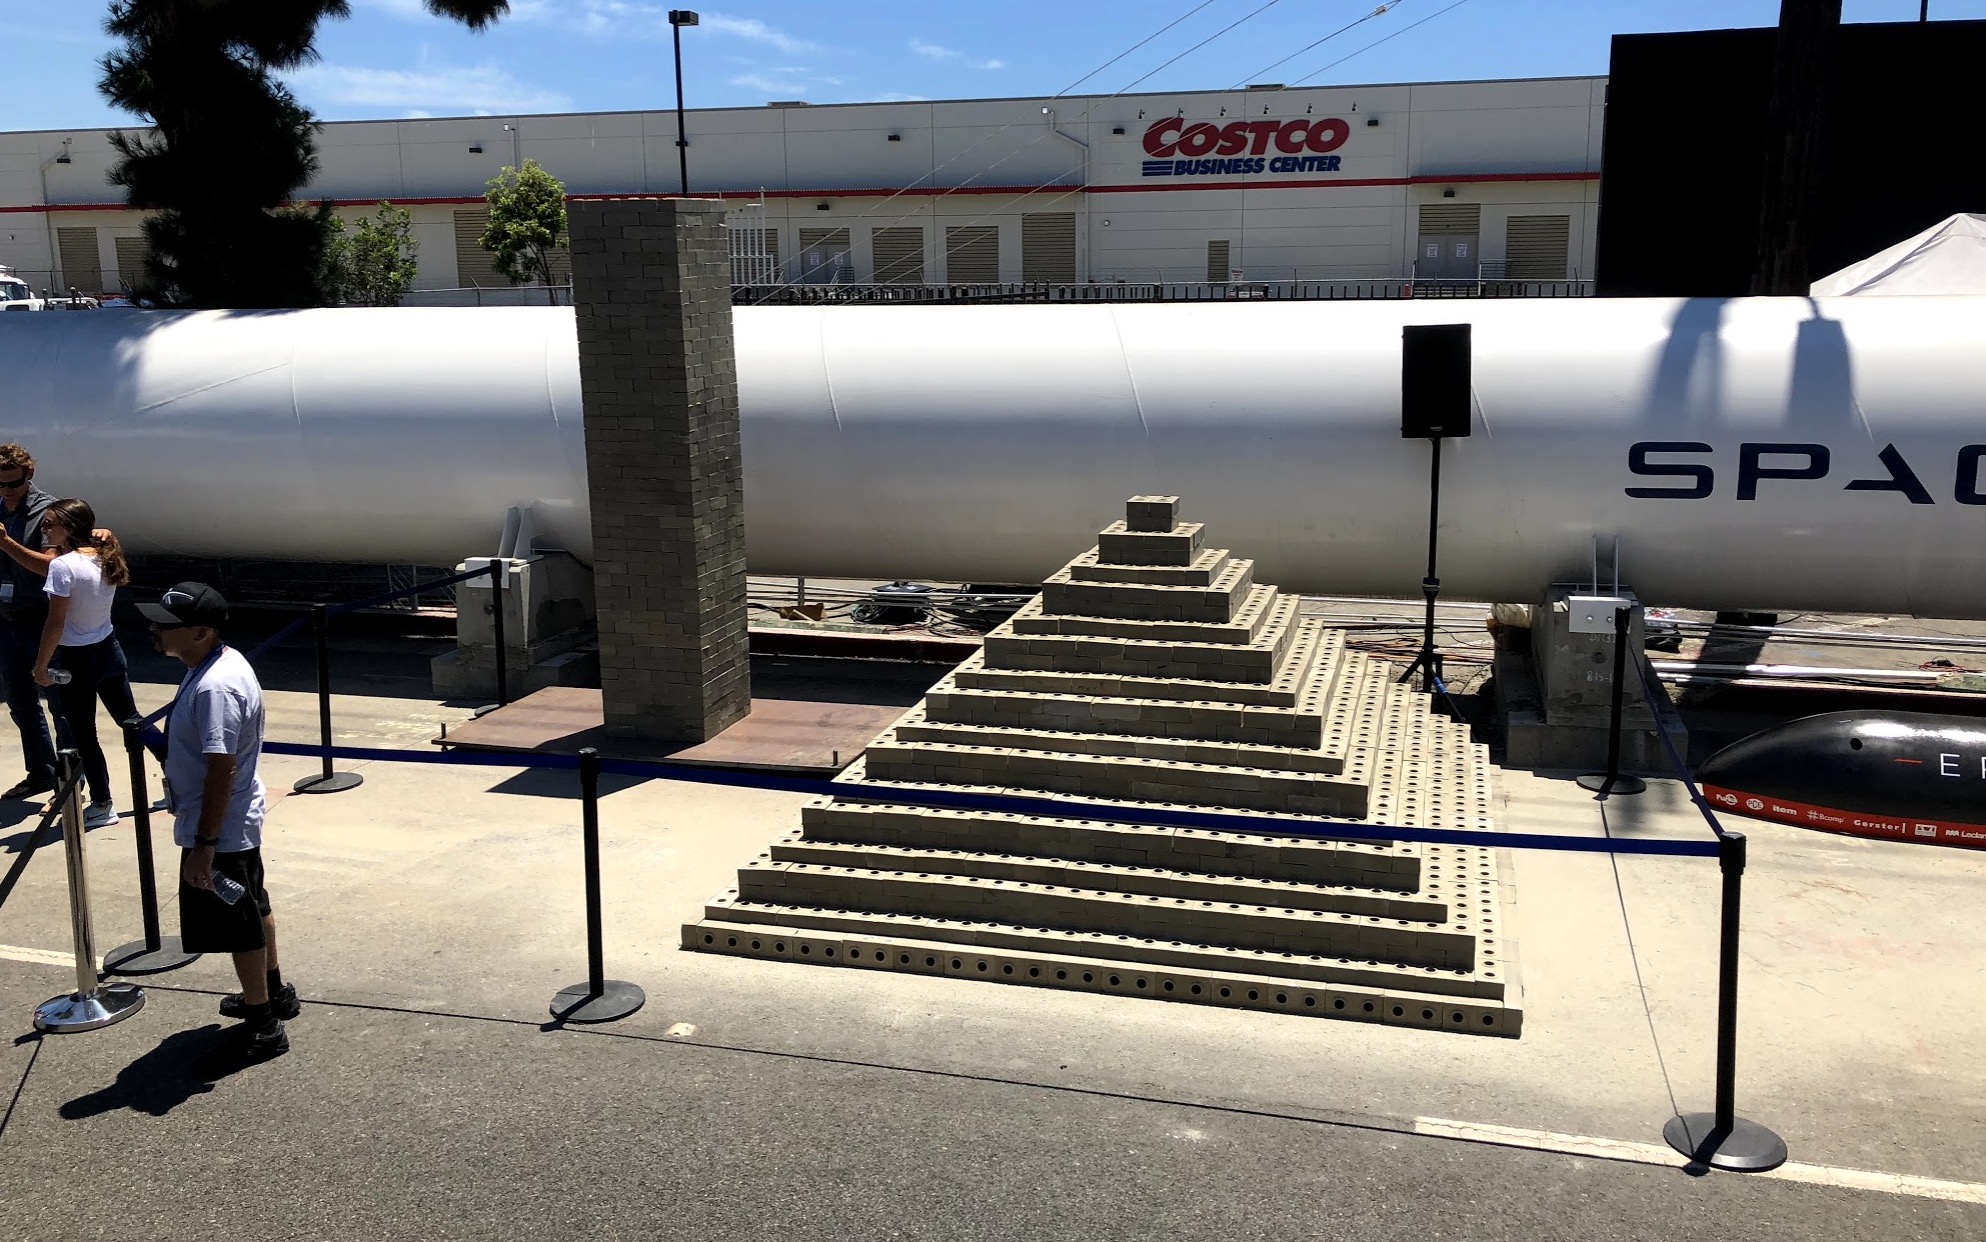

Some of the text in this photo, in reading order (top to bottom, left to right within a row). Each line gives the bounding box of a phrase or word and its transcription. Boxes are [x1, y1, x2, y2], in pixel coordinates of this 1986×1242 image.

[1142, 117, 1350, 158] COSTCO
[1173, 155, 1342, 176] BUSINESS CENTER
[1853, 819, 1900, 831] Gerster
